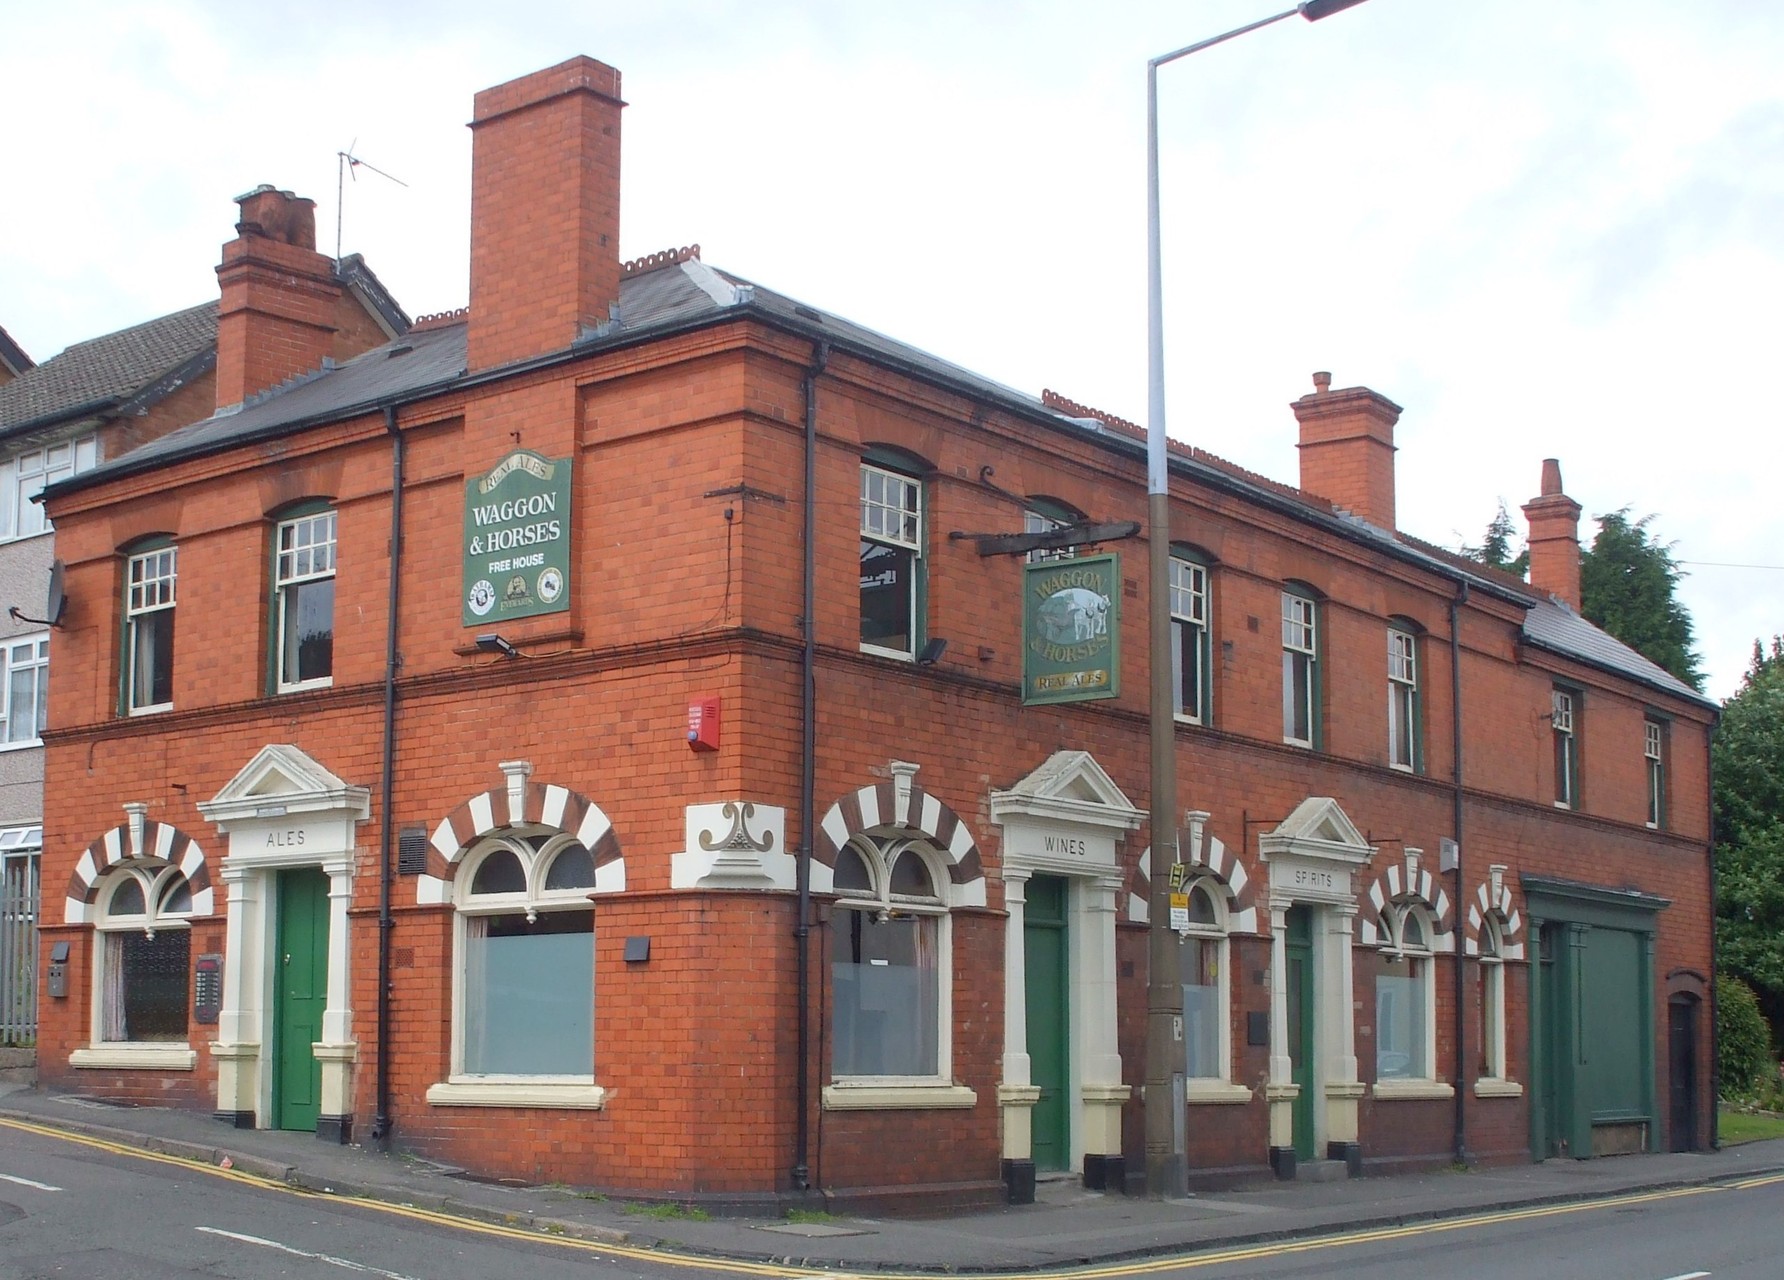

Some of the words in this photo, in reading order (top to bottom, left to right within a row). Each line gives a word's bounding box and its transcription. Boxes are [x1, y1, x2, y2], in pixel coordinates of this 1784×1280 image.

[485, 461, 513, 492] REAL
[517, 455, 548, 478] ALES
[473, 491, 557, 528] WAGGON
[470, 535, 484, 556] &
[486, 519, 561, 553] HORSES
[488, 558, 512, 574] FREE
[512, 552, 545, 570] HOUSE
[1035, 569, 1107, 599] WAGGON
[1044, 635, 1109, 663] HORSES
[1038, 676, 1070, 690] REAL
[1072, 672, 1102, 687] ALES
[266, 830, 305, 847] ALES
[1045, 836, 1085, 855] WINES
[1295, 870, 1332, 887] SPIRITS
